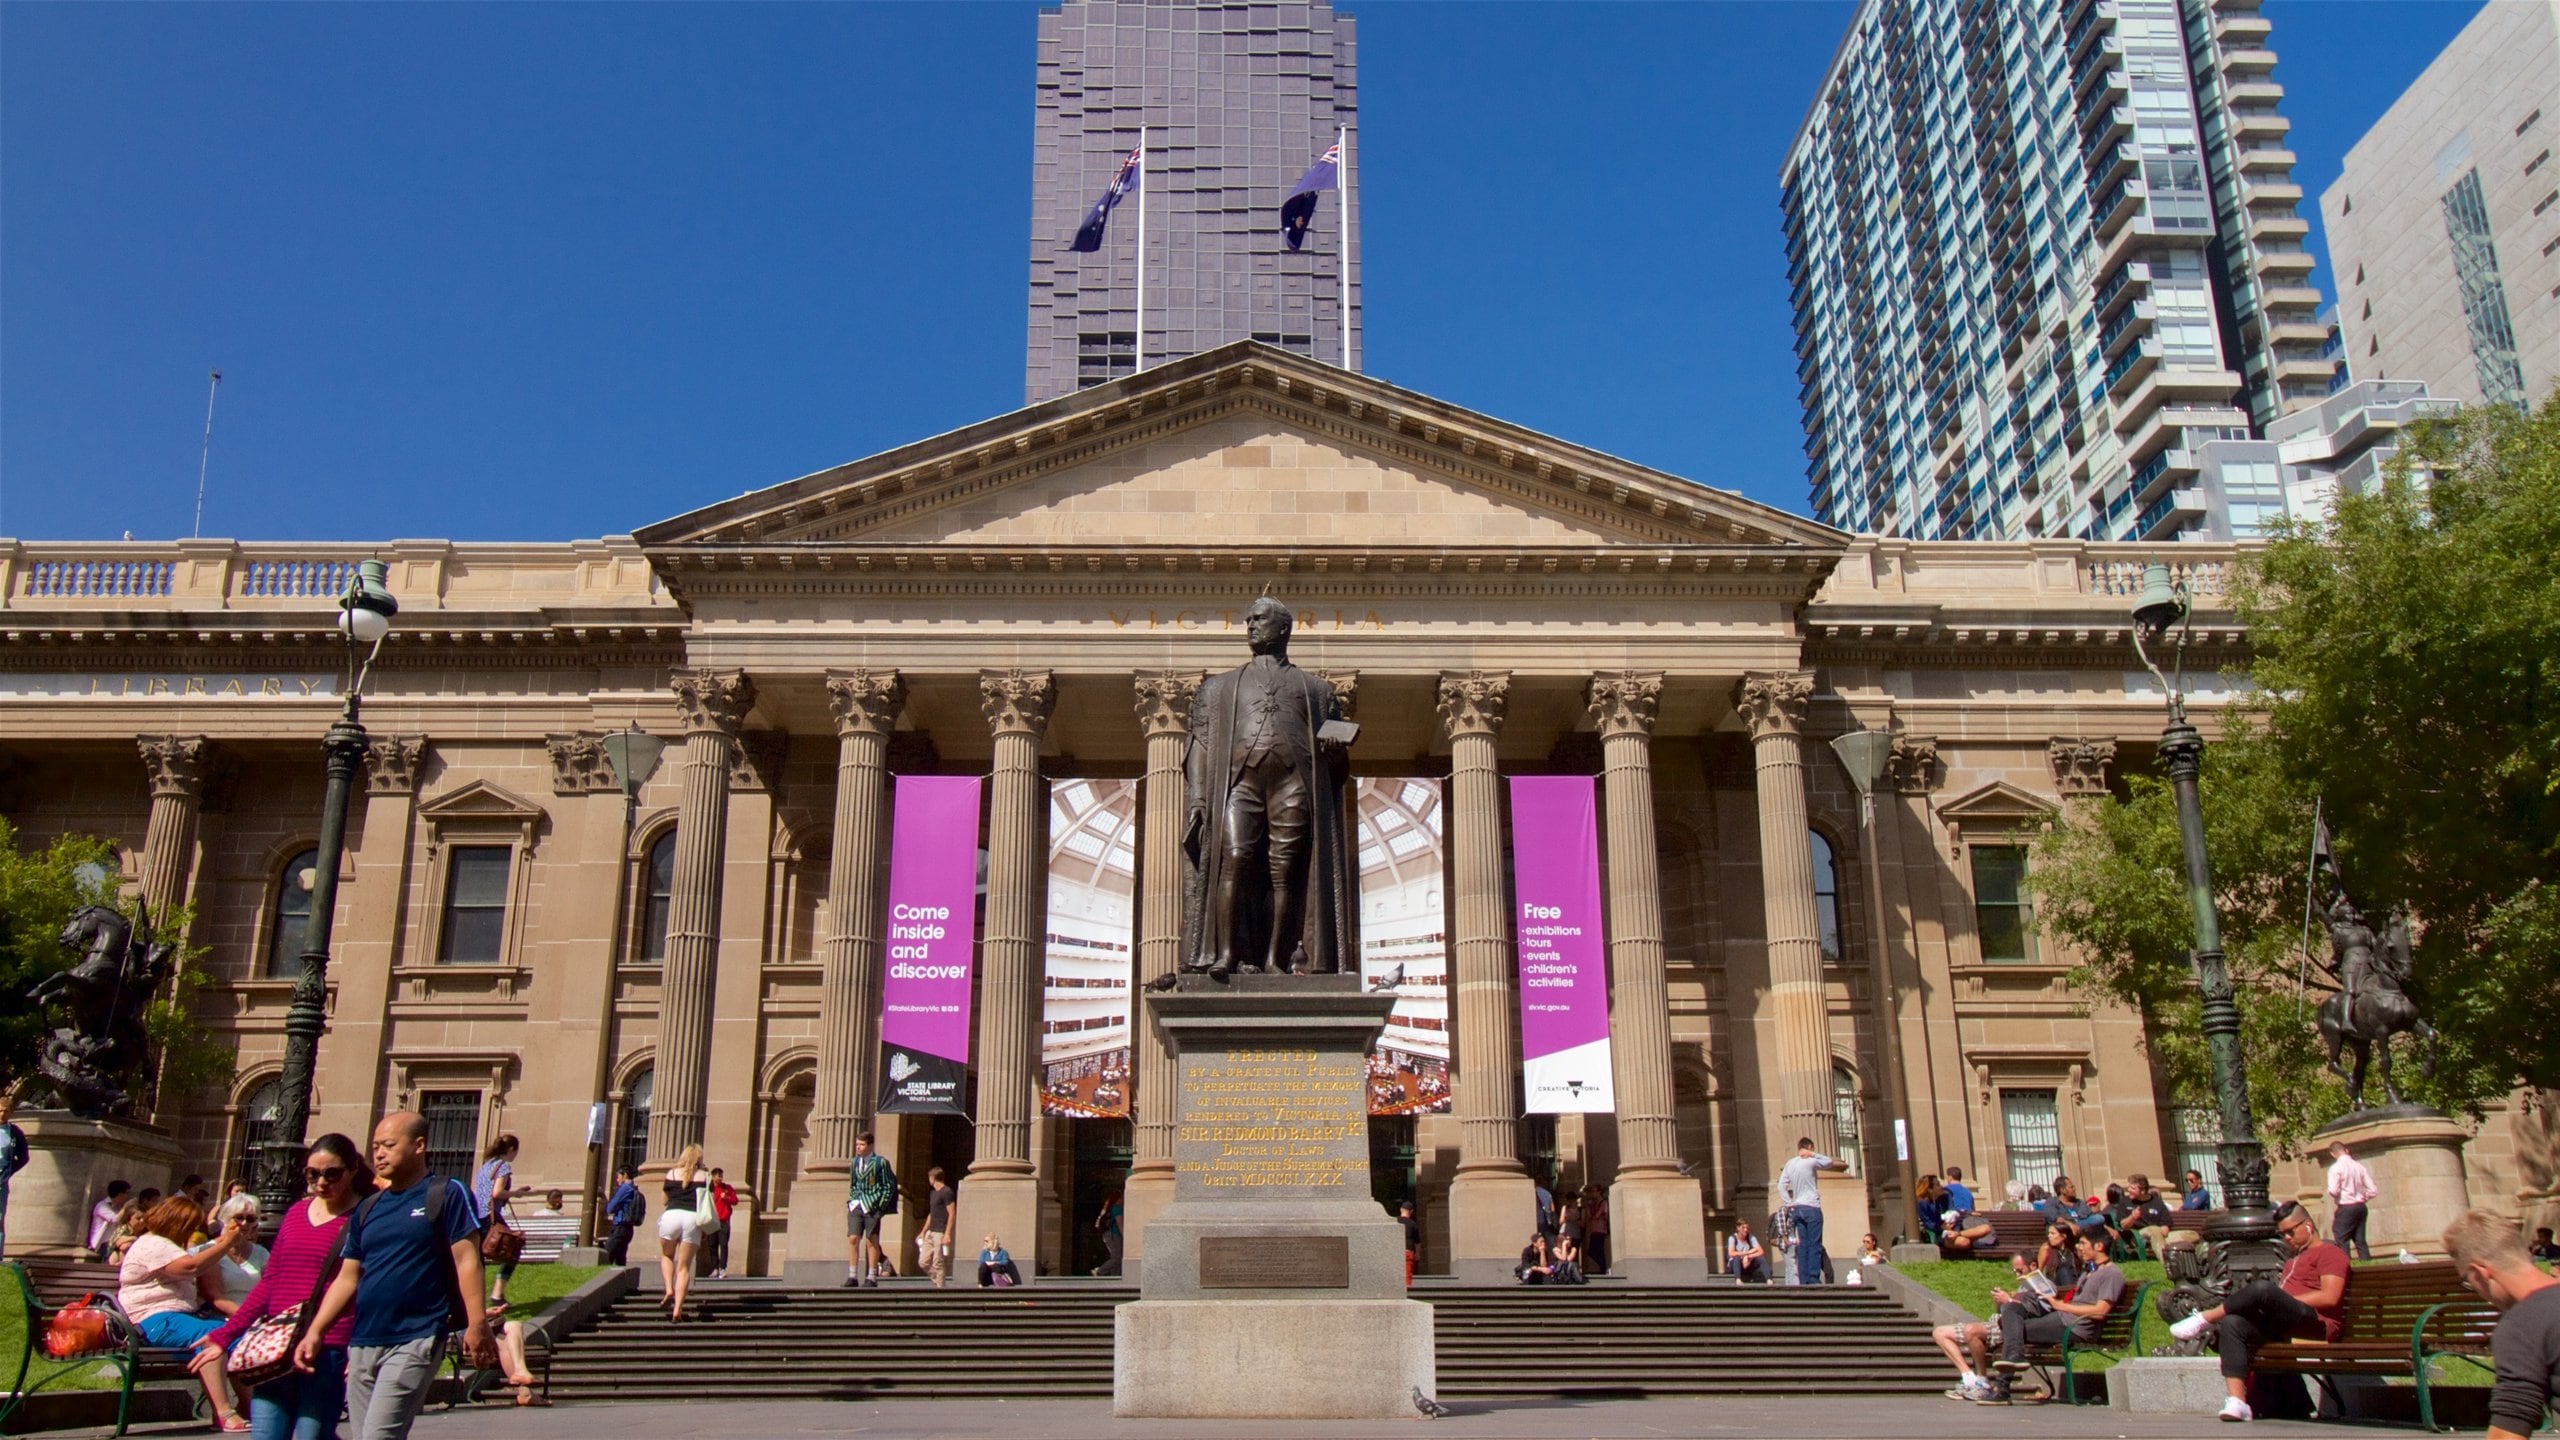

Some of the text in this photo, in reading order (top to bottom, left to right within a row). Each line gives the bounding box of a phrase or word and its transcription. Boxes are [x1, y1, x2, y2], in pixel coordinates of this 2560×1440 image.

[1106, 608, 1386, 631] VICTRIA
[90, 677, 321, 696] LIBRARY
[893, 903, 949, 920] Come
[1523, 903, 1562, 919] Free
[892, 923, 945, 940] inside
[1525, 926, 1582, 936] exhibitions
[1526, 938, 1552, 948] tours
[891, 944, 928, 959] and
[1527, 952, 1561, 961] events
[890, 963, 967, 979] discover
[1527, 964, 1577, 974] children's
[1528, 977, 1574, 987] activities
[1227, 1050, 1317, 1062] ERECTED
[1210, 1068, 1220, 1077] A
[1226, 1068, 1300, 1077] GRATEFUL
[1184, 1082, 1360, 1091] TO PERPETUATE THE MEMORY
[1197, 1097, 1348, 1106] OF INVALUABLE SERVICES
[1185, 1112, 1248, 1121] RENDERED
[1254, 1112, 1268, 1120] TO
[1271, 1107, 1341, 1120] VICTORIA
[1180, 1127, 1209, 1141] SIR
[1212, 1127, 1287, 1141] REDMOND
[1289, 1126, 1344, 1140] BARRY
[1222, 1143, 1325, 1155] DOCTOR OF LAWS
[1178, 1161, 1201, 1171] AND
[1202, 1161, 1210, 1171] A
[1246, 1161, 1258, 1170] OF
[1260, 1161, 1281, 1170] THE
[1282, 1158, 1333, 1170] SUPREME
